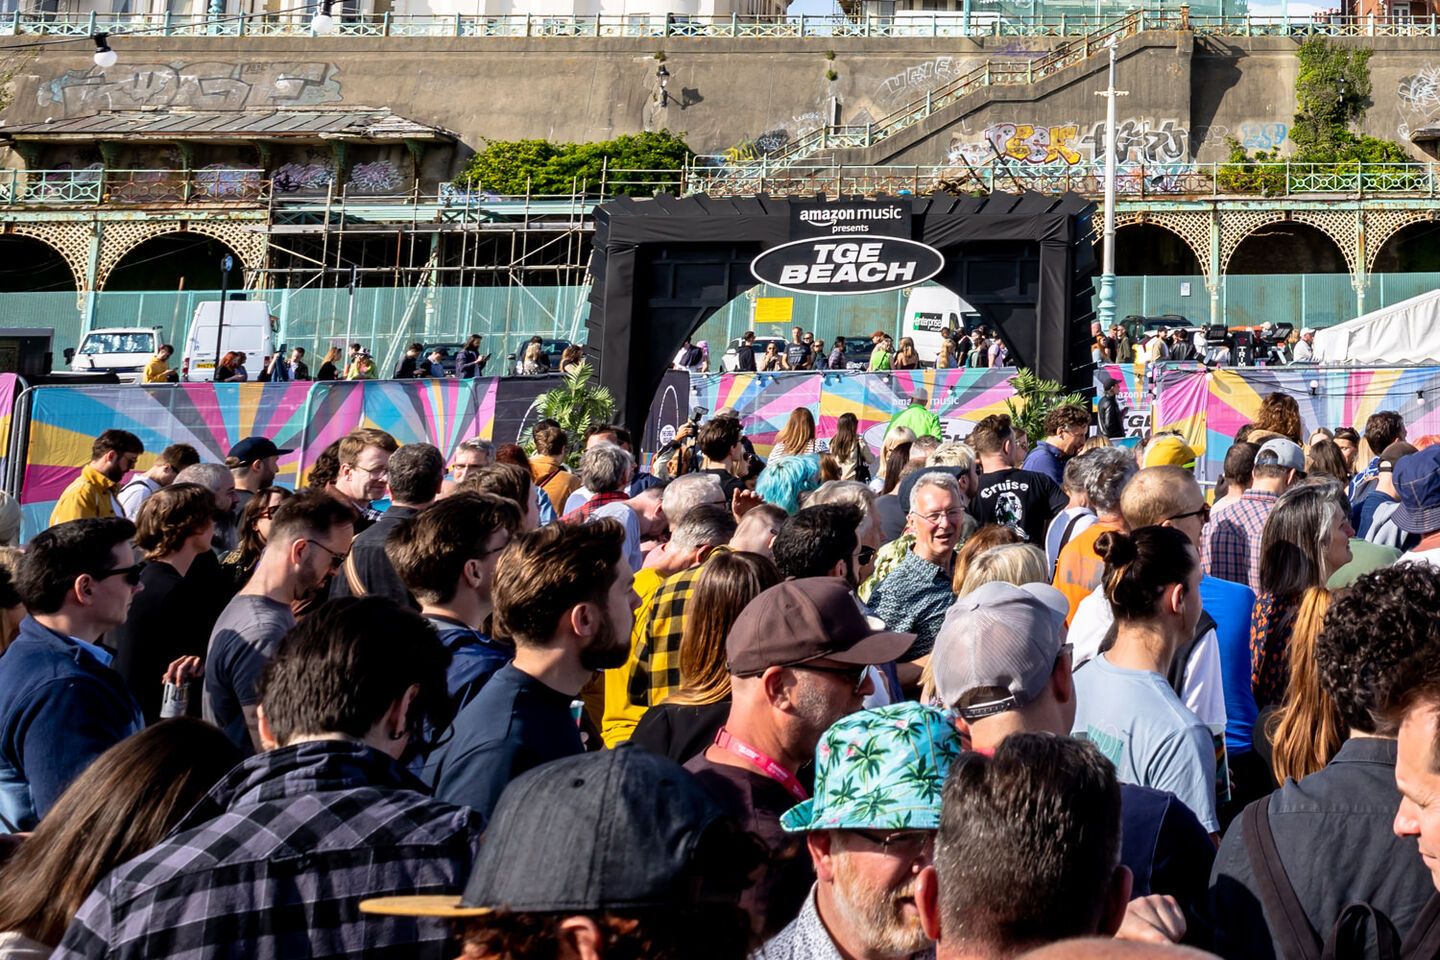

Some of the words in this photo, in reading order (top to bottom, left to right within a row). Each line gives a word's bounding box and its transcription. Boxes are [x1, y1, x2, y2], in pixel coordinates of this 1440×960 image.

[800, 208, 855, 221] amazon
[857, 205, 902, 220] music
[832, 224, 869, 234] presents
[813, 243, 883, 264] TGE
[779, 261, 917, 284] BEACH
[929, 396, 959, 405] music
[980, 480, 1029, 499] Cruise
